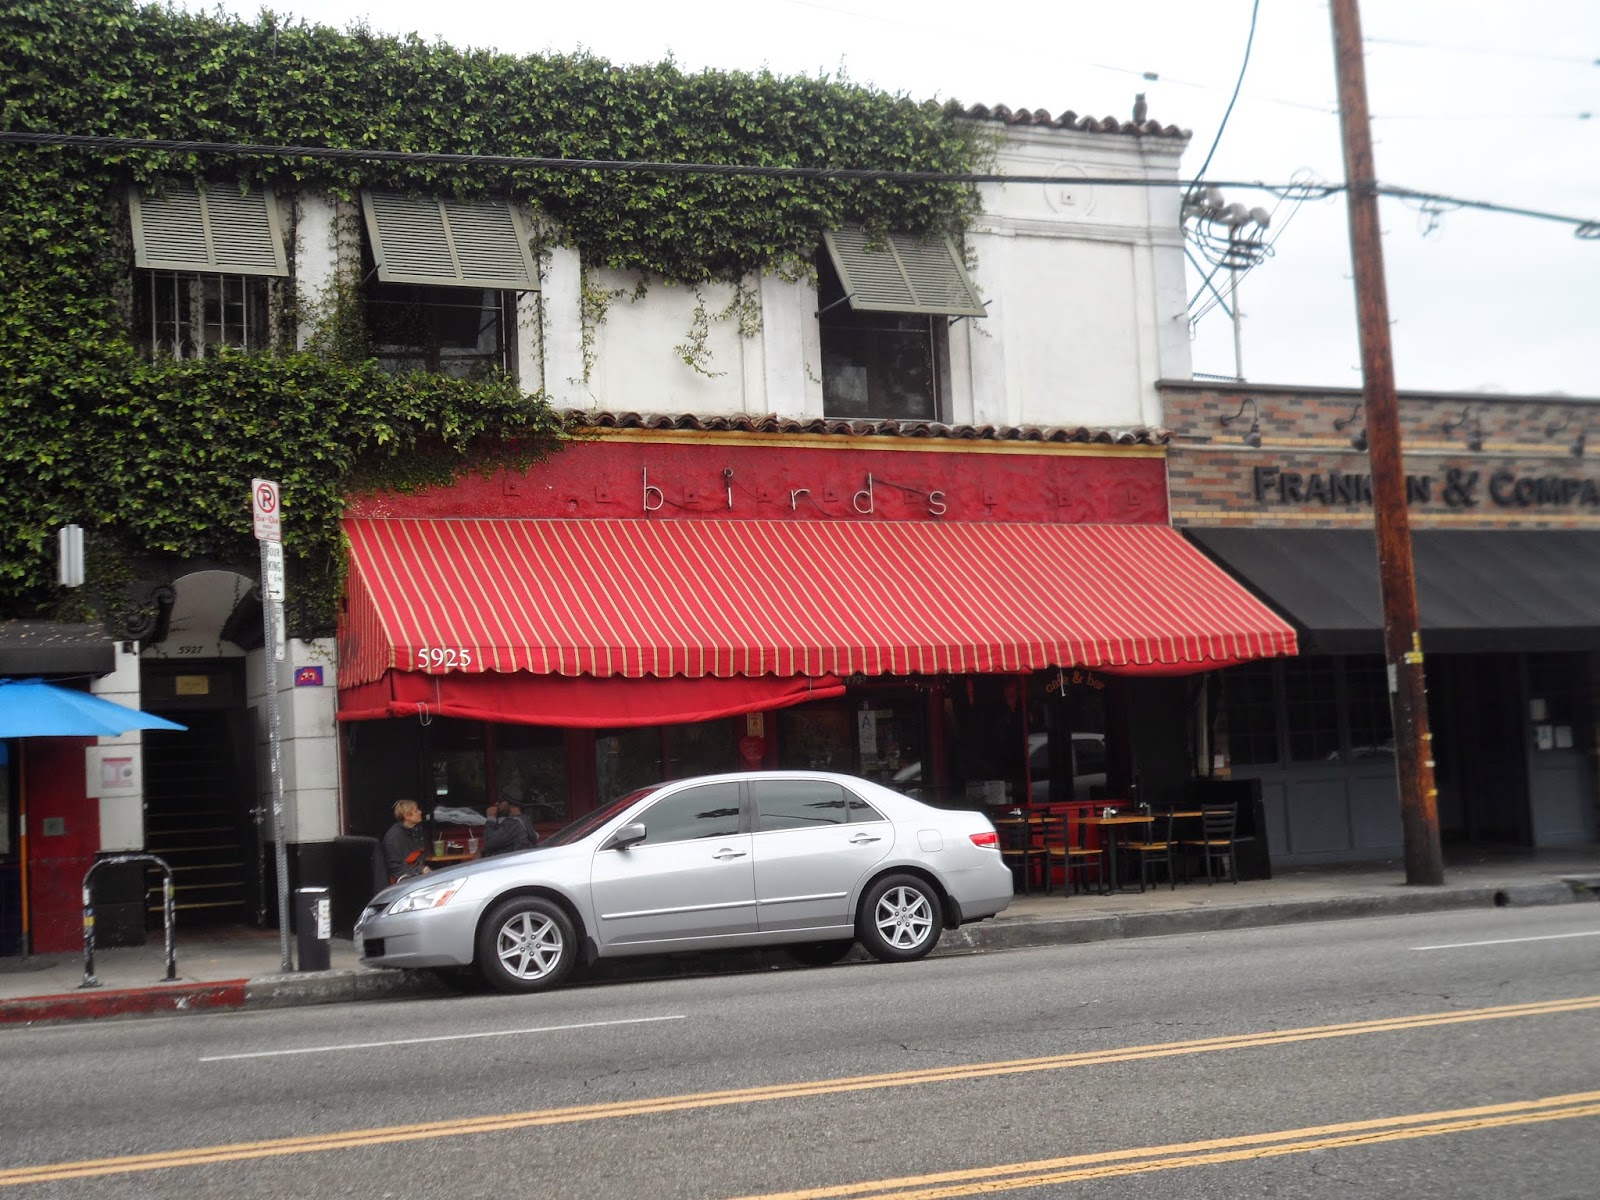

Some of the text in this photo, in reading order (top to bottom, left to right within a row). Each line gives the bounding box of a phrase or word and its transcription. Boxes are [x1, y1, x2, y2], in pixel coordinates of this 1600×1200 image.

[643, 467, 947, 515] birds
[1253, 465, 1431, 505] FRANKN
[1442, 467, 1480, 508] &
[177, 645, 204, 655] 5927
[417, 647, 471, 668] 5925
[1072, 670, 1084, 684] &
[1087, 672, 1105, 690] bar
[861, 714, 872, 729] A
